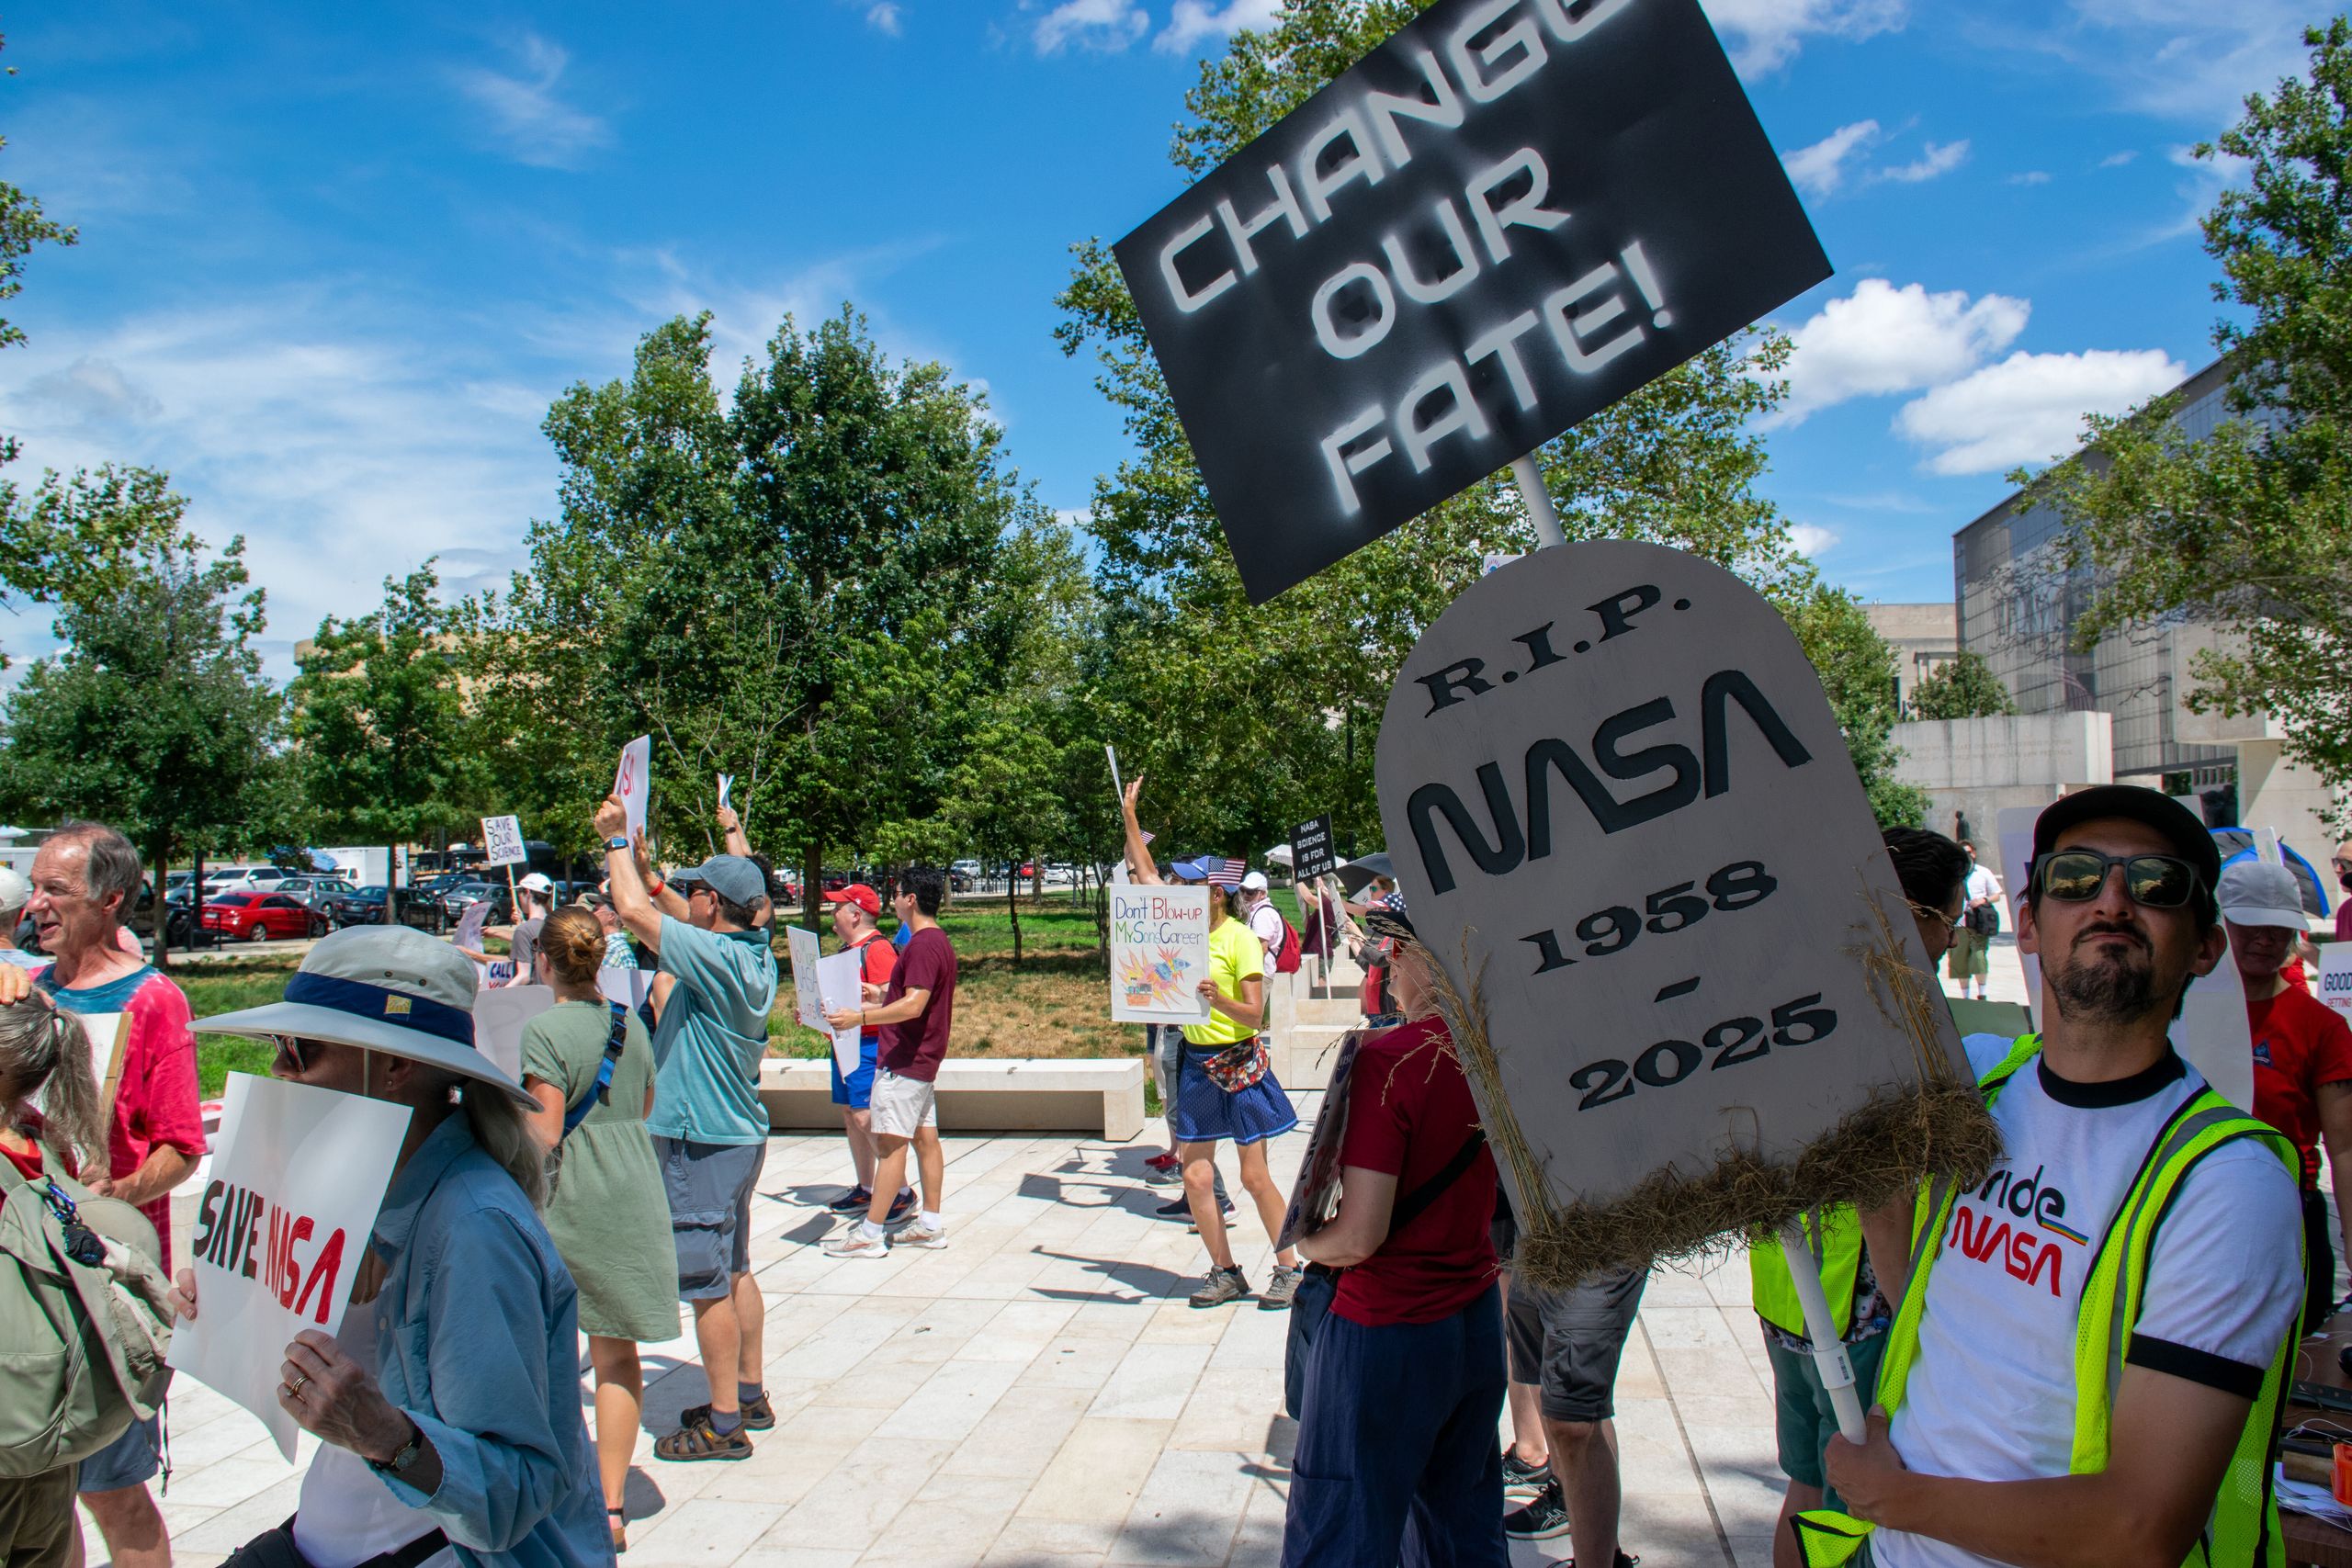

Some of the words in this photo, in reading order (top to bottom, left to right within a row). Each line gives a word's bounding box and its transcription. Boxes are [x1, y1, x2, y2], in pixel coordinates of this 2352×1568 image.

[1311, 147, 1571, 359] OUR
[1320, 240, 1672, 517] FATE!
[1413, 584, 1692, 718] R.I.P.
[1406, 669, 1815, 896] NASA
[485, 818, 513, 835] SAVE
[1300, 819, 1319, 834] NASA
[492, 832, 514, 847] OUR
[1296, 831, 1326, 850] SCIENCE
[491, 845, 522, 861] SCIENCE
[1301, 852, 1309, 863] IS
[1310, 848, 1325, 860] FOR
[1297, 868, 1311, 879] ALL
[1311, 863, 1321, 874] OF
[1322, 860, 1332, 872] US
[1115, 897, 1148, 919] Don't
[1518, 860, 1778, 976] 1958
[1159, 922, 1204, 945] Career
[490, 962, 512, 979] CALL
[1568, 992, 1838, 1111] 2025
[1978, 1165, 2065, 1227] ride
[193, 1179, 265, 1281] SAVE
[265, 1202, 345, 1325] NASA
[1949, 1206, 2062, 1298] NASA
